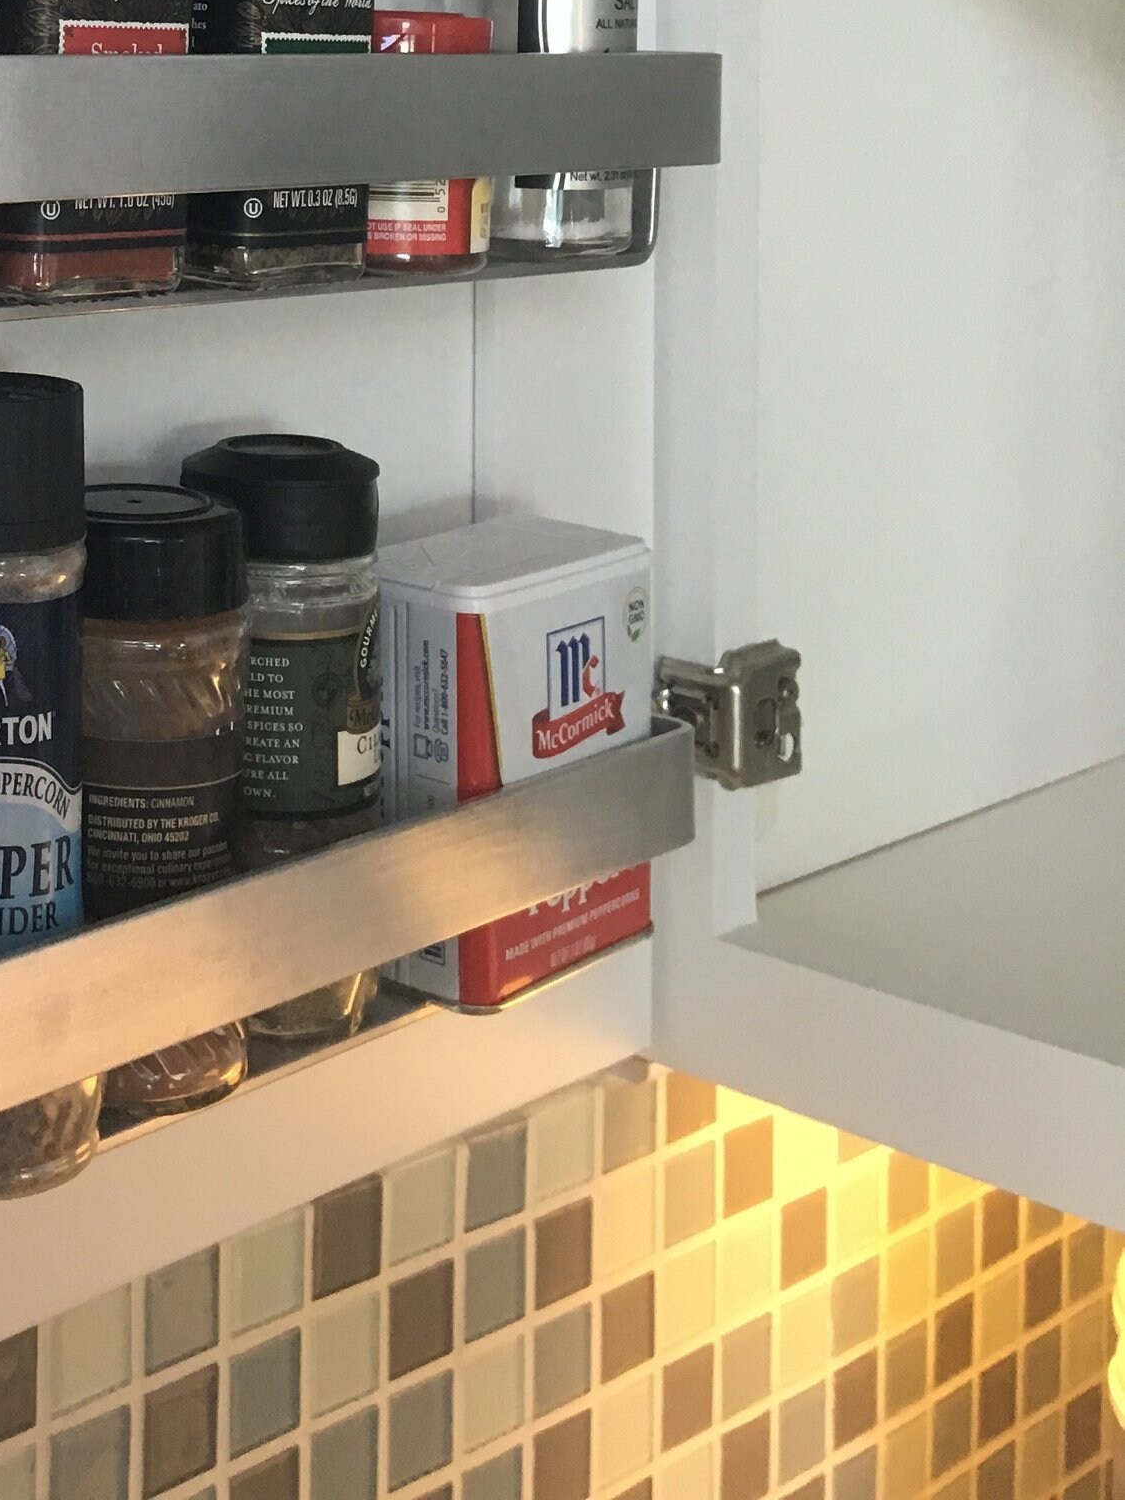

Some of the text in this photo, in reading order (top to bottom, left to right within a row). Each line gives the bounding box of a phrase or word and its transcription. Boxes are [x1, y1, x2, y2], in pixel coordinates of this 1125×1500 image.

[273, 188, 357, 209] NET WT. 0.3 OZ (8.5G)
[377, 222, 393, 231] USE
[267, 674, 283, 683] TO
[263, 690, 295, 700] MOST
[245, 704, 294, 716] REMIUM
[247, 721, 304, 732] SPICES SO
[536, 698, 615, 751] McCormick
[245, 736, 300, 748] REATE AN
[255, 754, 299, 765] FLAVOR
[267, 771, 289, 780] ALL
[89, 793, 195, 809] INGREDIENTS: CINNAMON
[88, 814, 145, 829] DISTRIBUTED
[146, 819, 159, 829] BY
[161, 818, 176, 828] THE
[178, 813, 208, 828] KROGER
[87, 828, 140, 844] CINCINNATI,
[141, 832, 163, 843] OHIO
